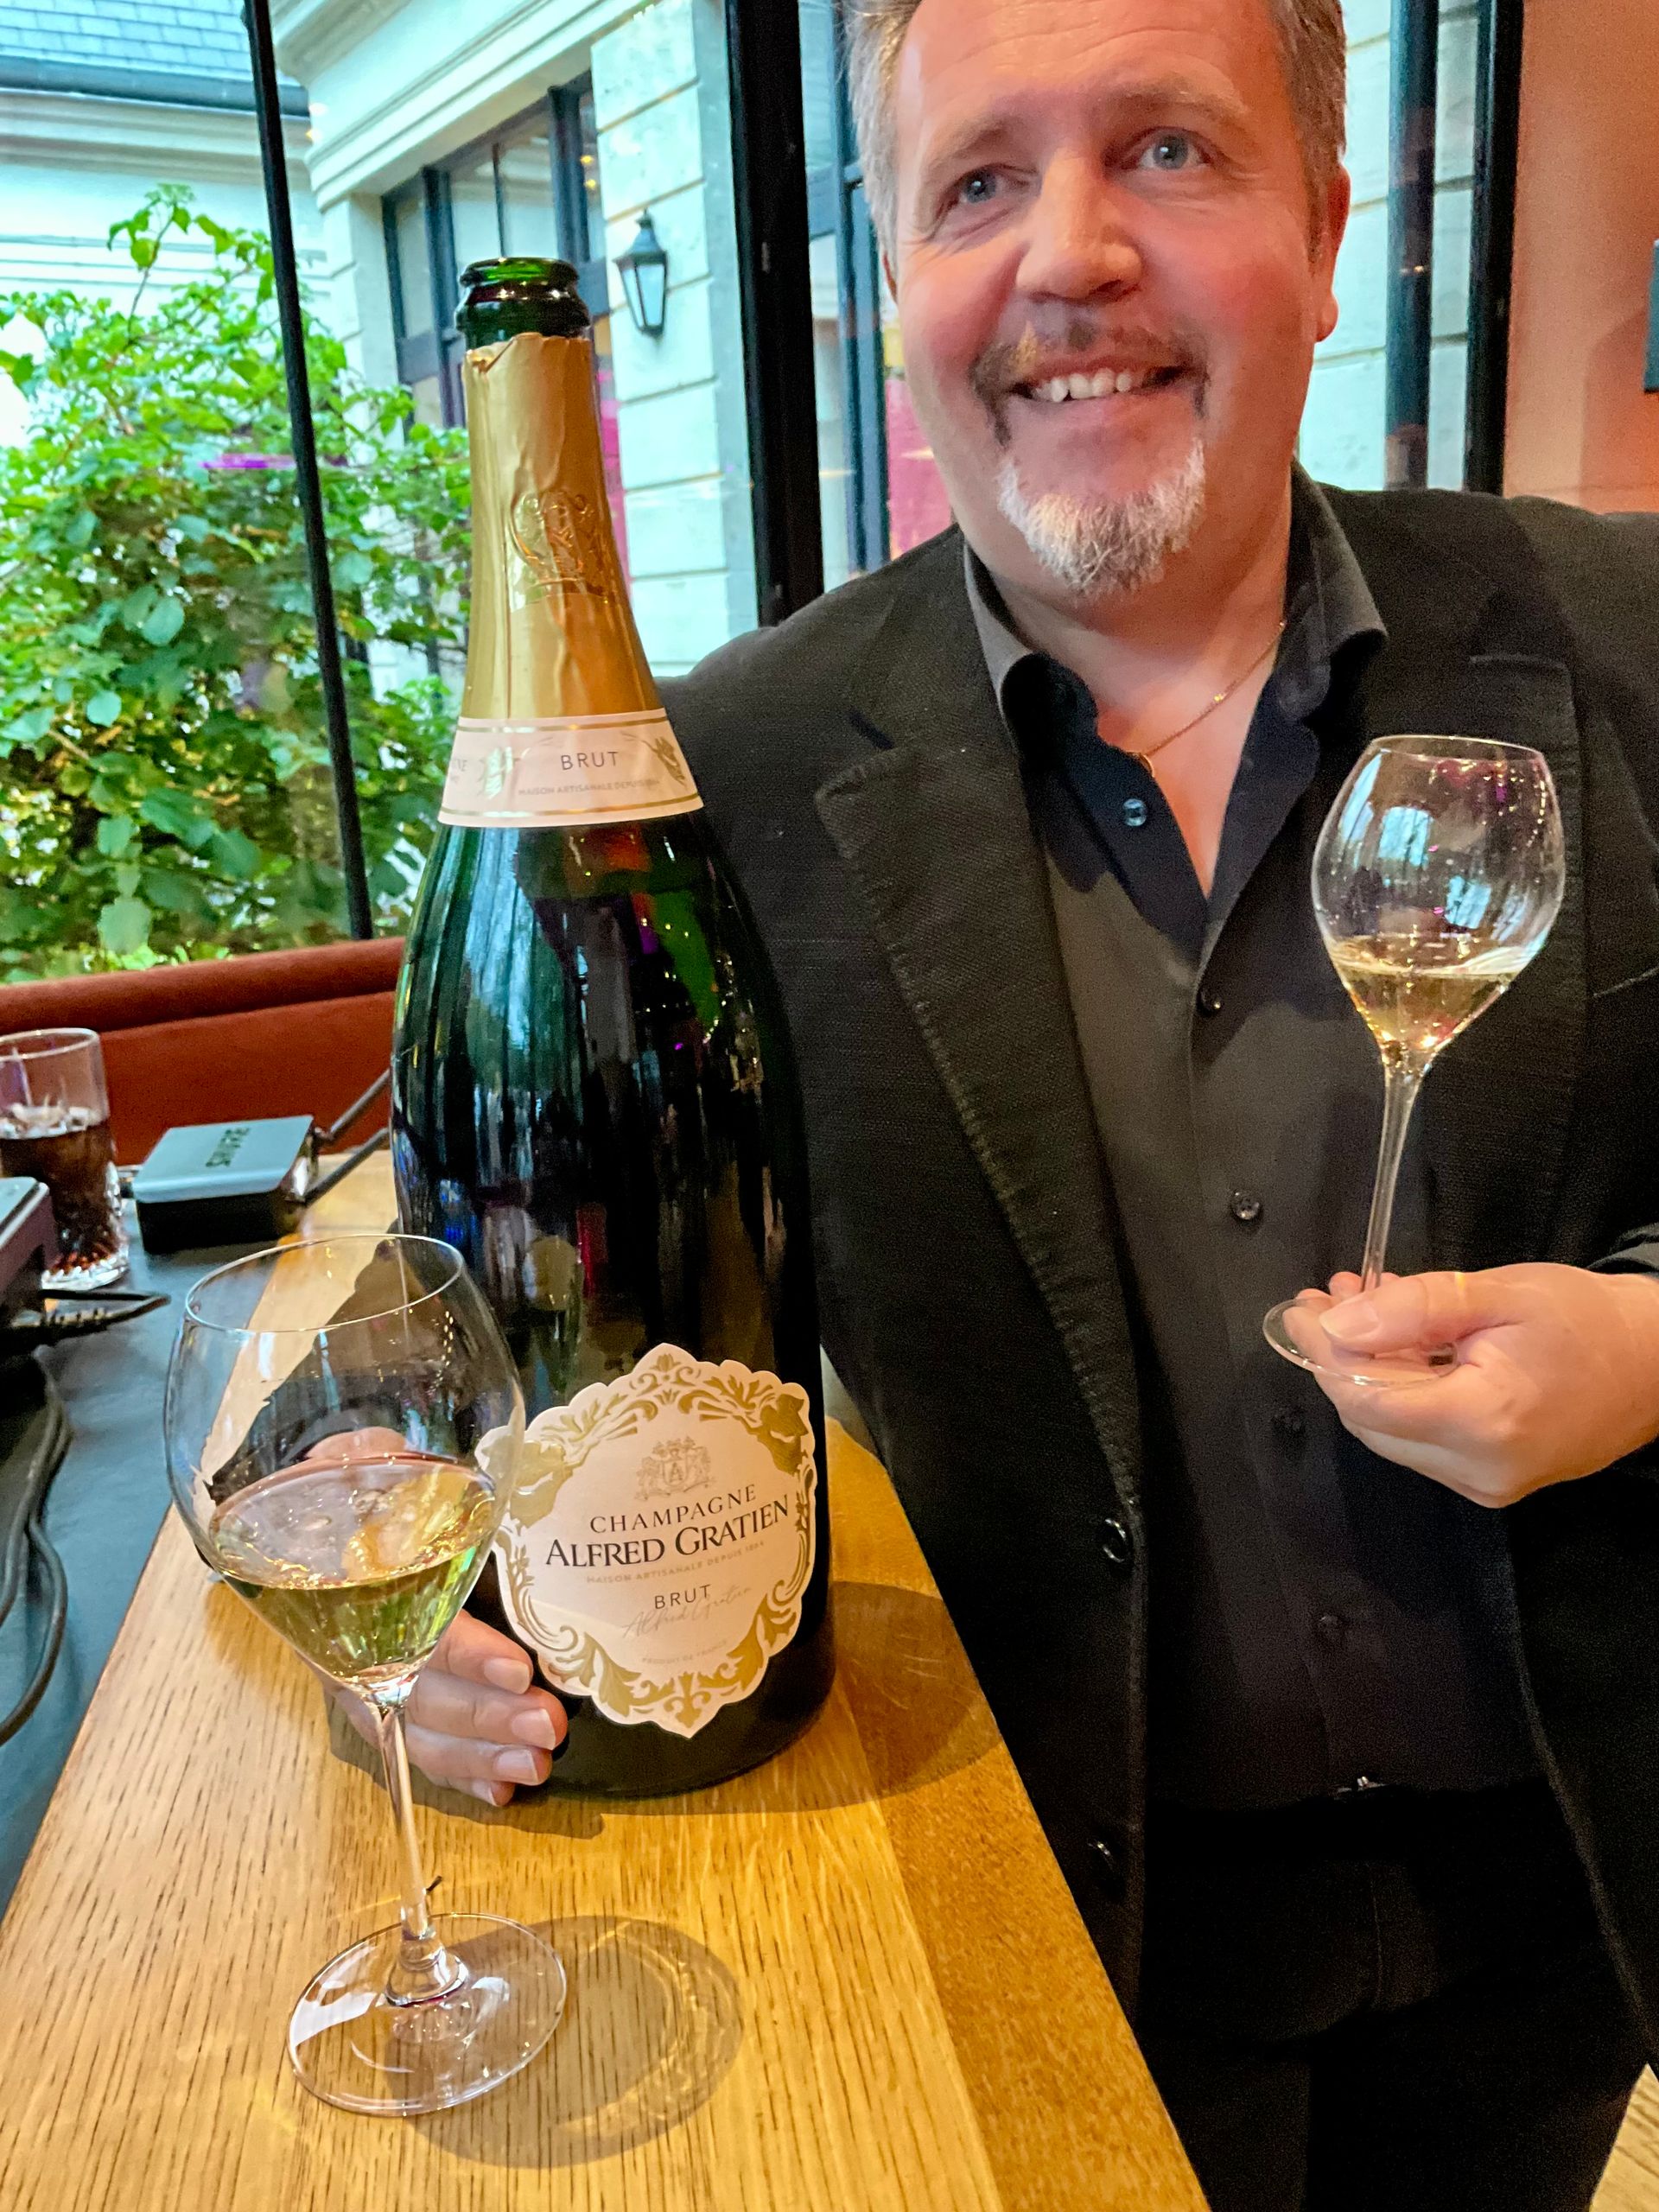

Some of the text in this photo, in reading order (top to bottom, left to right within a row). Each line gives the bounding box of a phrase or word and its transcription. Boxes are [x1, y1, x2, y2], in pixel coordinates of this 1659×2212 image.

[561, 751, 620, 772] BRUT
[589, 1484, 757, 1535] CHAMPAGNE
[545, 1496, 790, 1568] ALFRED GRATIEN
[586, 1573, 632, 1585] MAISON
[636, 1560, 703, 1581] ARTISANALE
[707, 1548, 742, 1567] DEPUIS
[653, 1583, 712, 1610] BRUT
